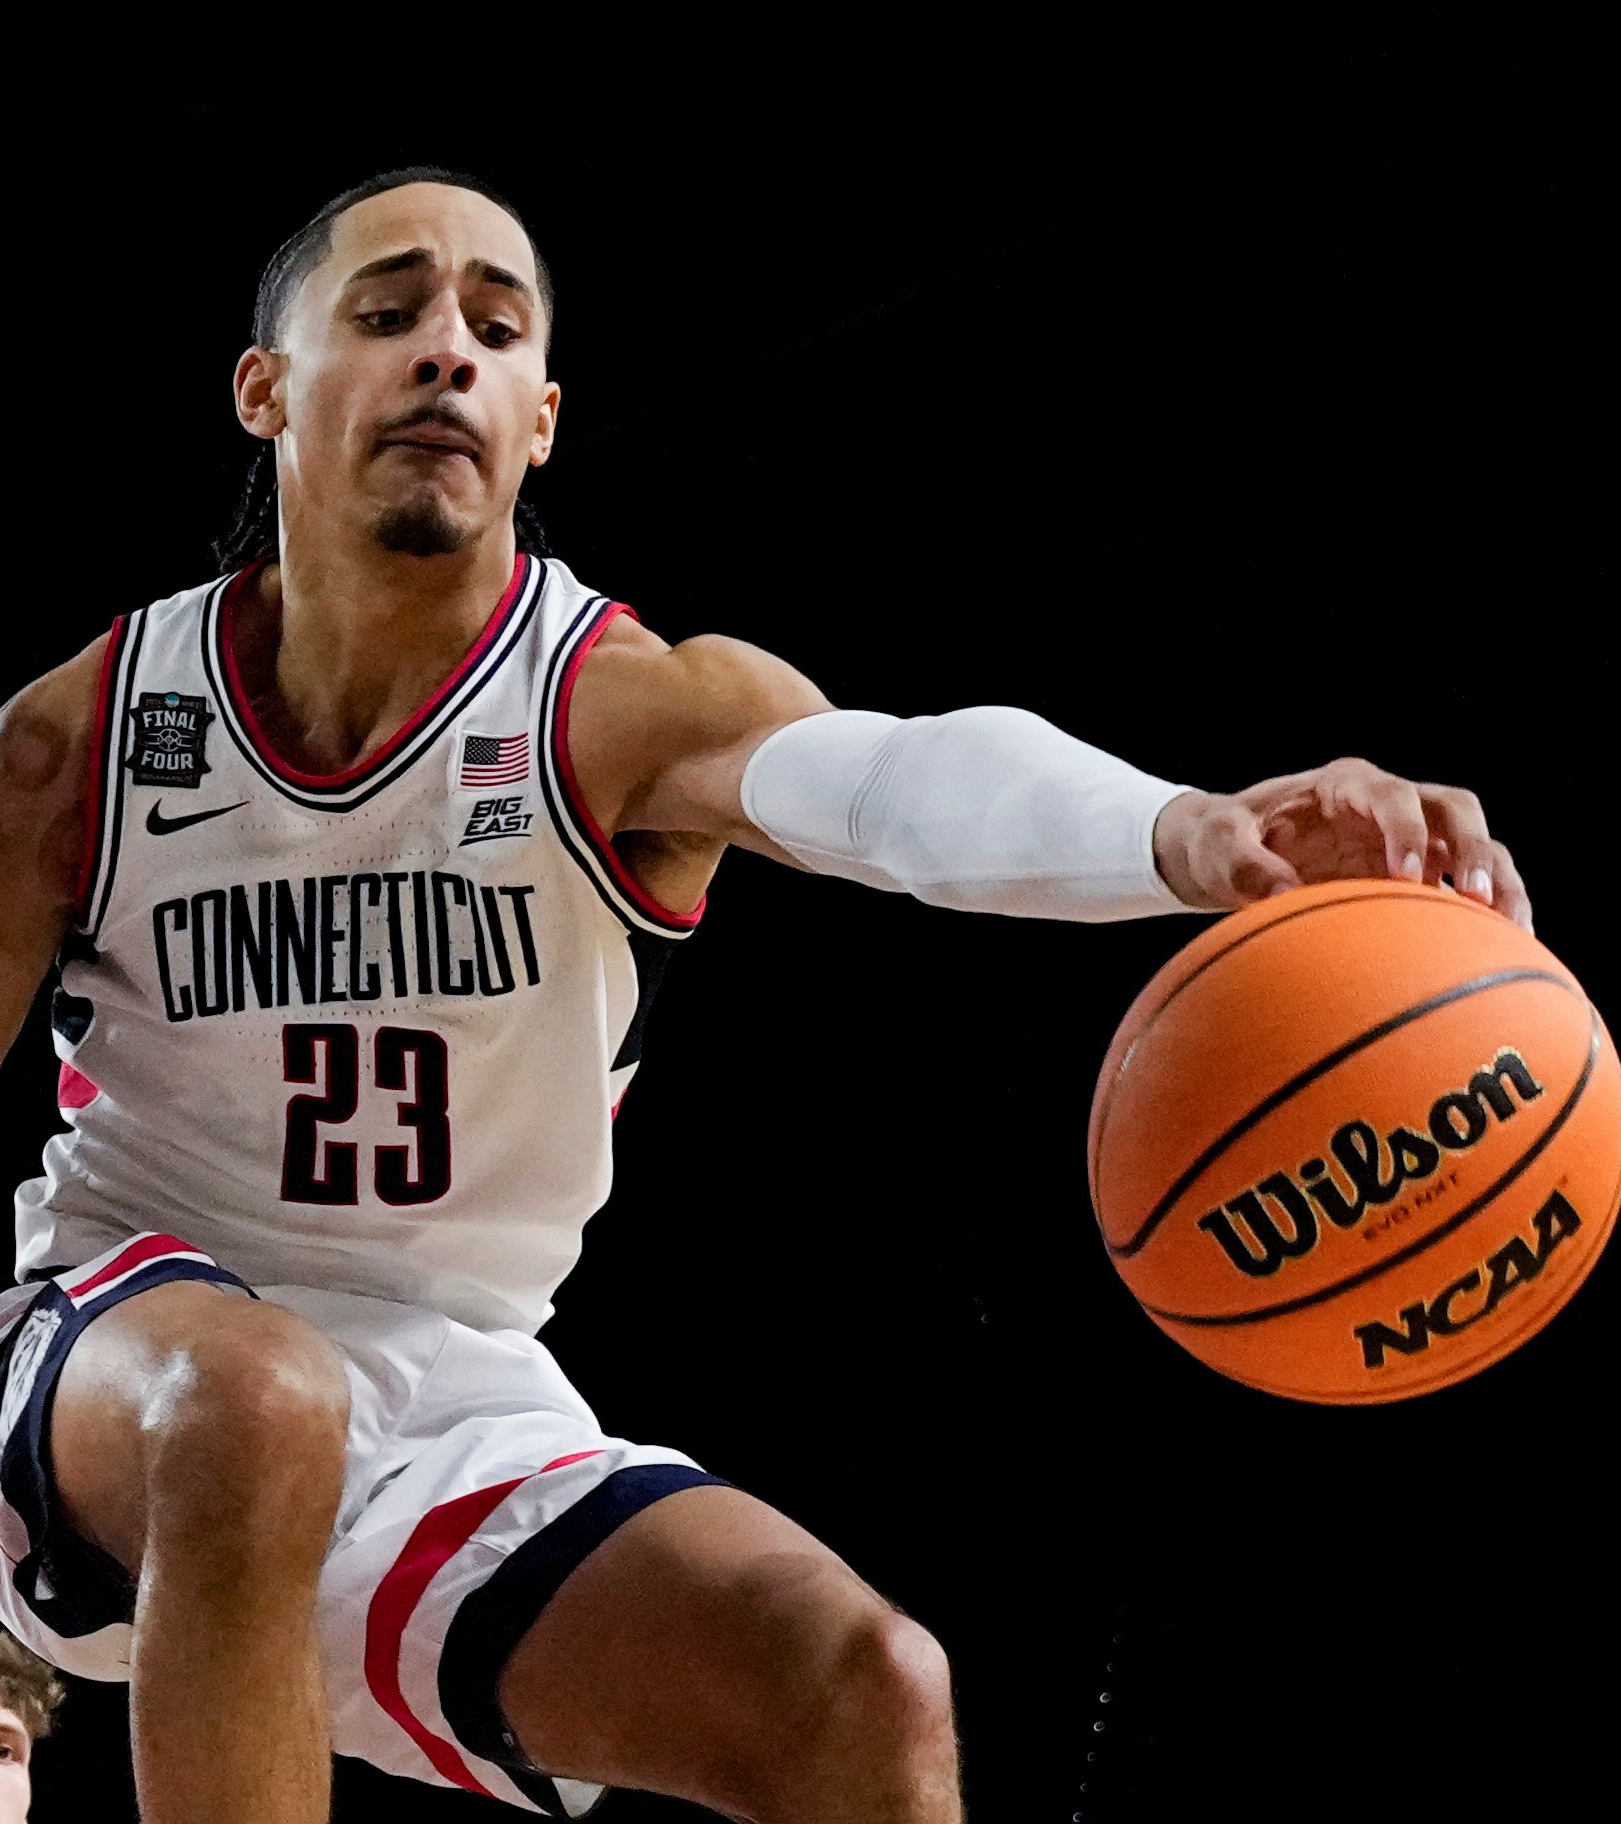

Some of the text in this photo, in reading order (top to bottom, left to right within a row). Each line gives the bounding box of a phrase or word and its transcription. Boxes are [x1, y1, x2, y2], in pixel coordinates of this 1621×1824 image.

[141, 750, 194, 771] FOUR
[142, 710, 197, 731] FINAL
[462, 812, 533, 838] EAST
[472, 797, 525, 817] BIG
[152, 870, 541, 1023] CONNECTICUT
[279, 1022, 452, 1207] 23
[1196, 1045, 1548, 1278] Wilson
[1353, 1186, 1586, 1370] NCAA
